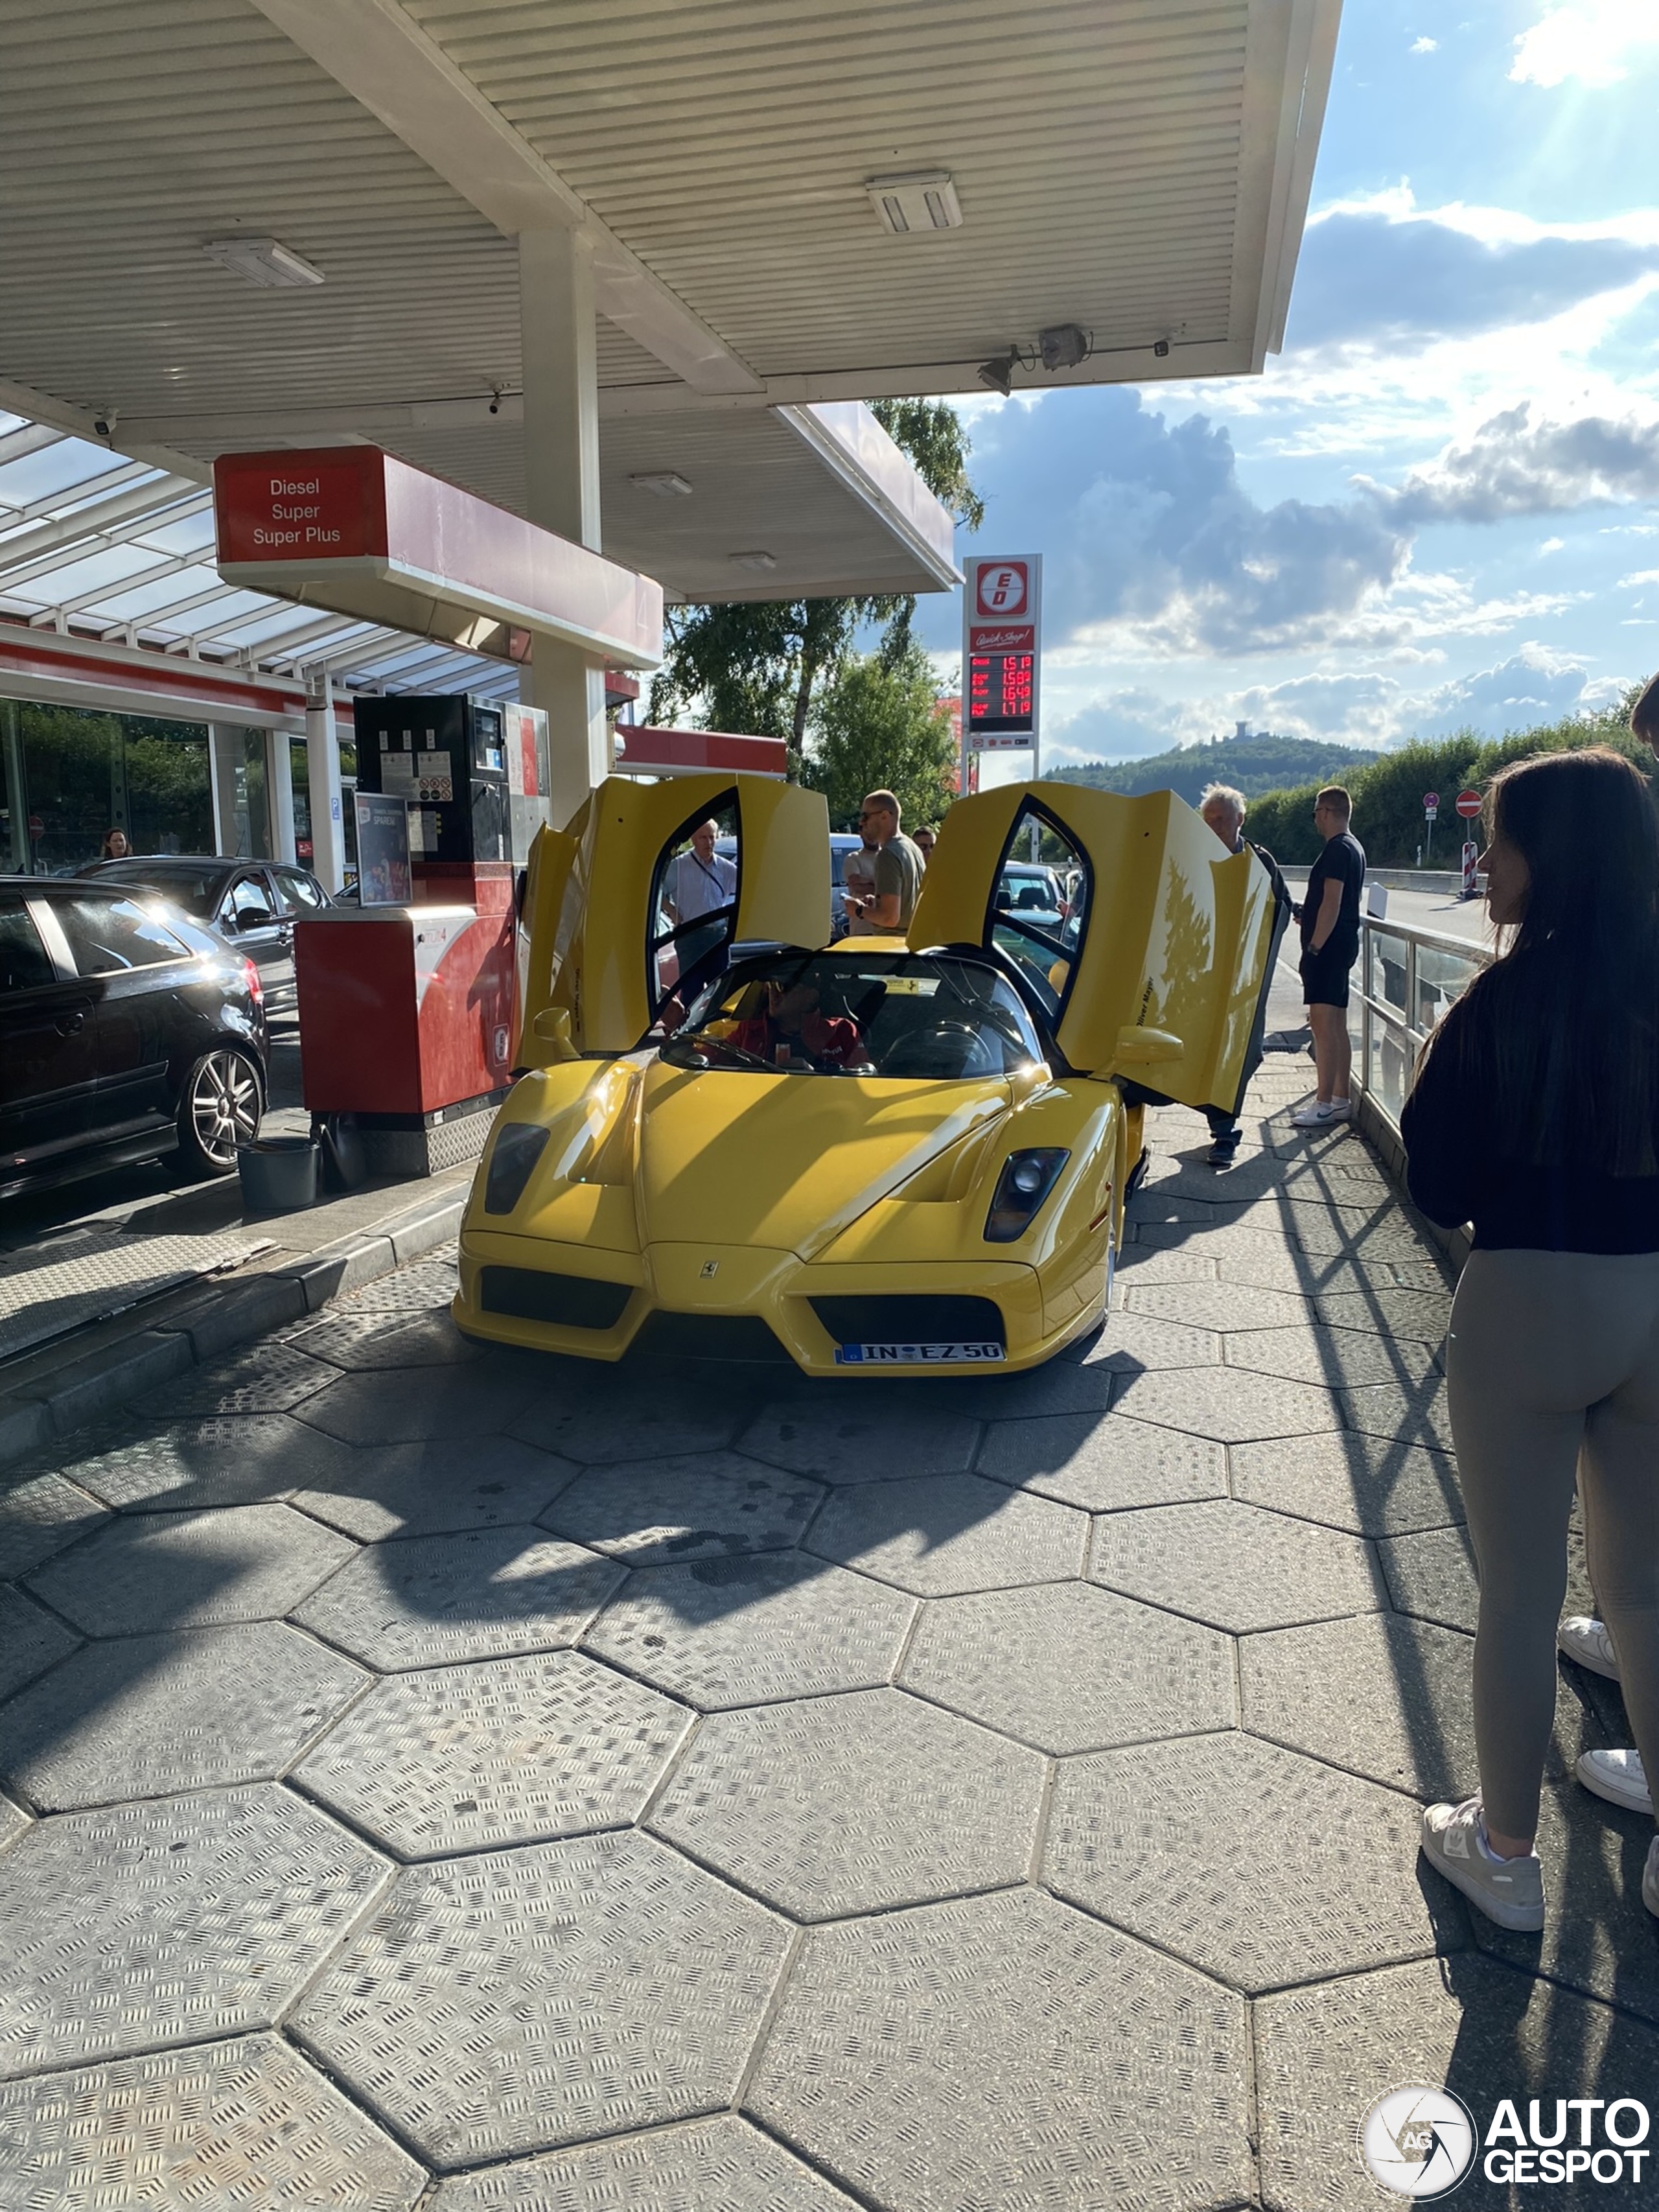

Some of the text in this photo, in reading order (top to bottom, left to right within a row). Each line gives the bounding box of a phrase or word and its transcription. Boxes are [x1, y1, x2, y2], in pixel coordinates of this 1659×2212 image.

[270, 478, 319, 496] Diesel
[272, 504, 320, 522] Super
[253, 526, 341, 547] Super Plus
[1143, 975, 1154, 1003] Mayer
[864, 1346, 898, 1360] IN
[920, 1345, 958, 1359] EZ
[963, 1344, 1001, 1358] 50
